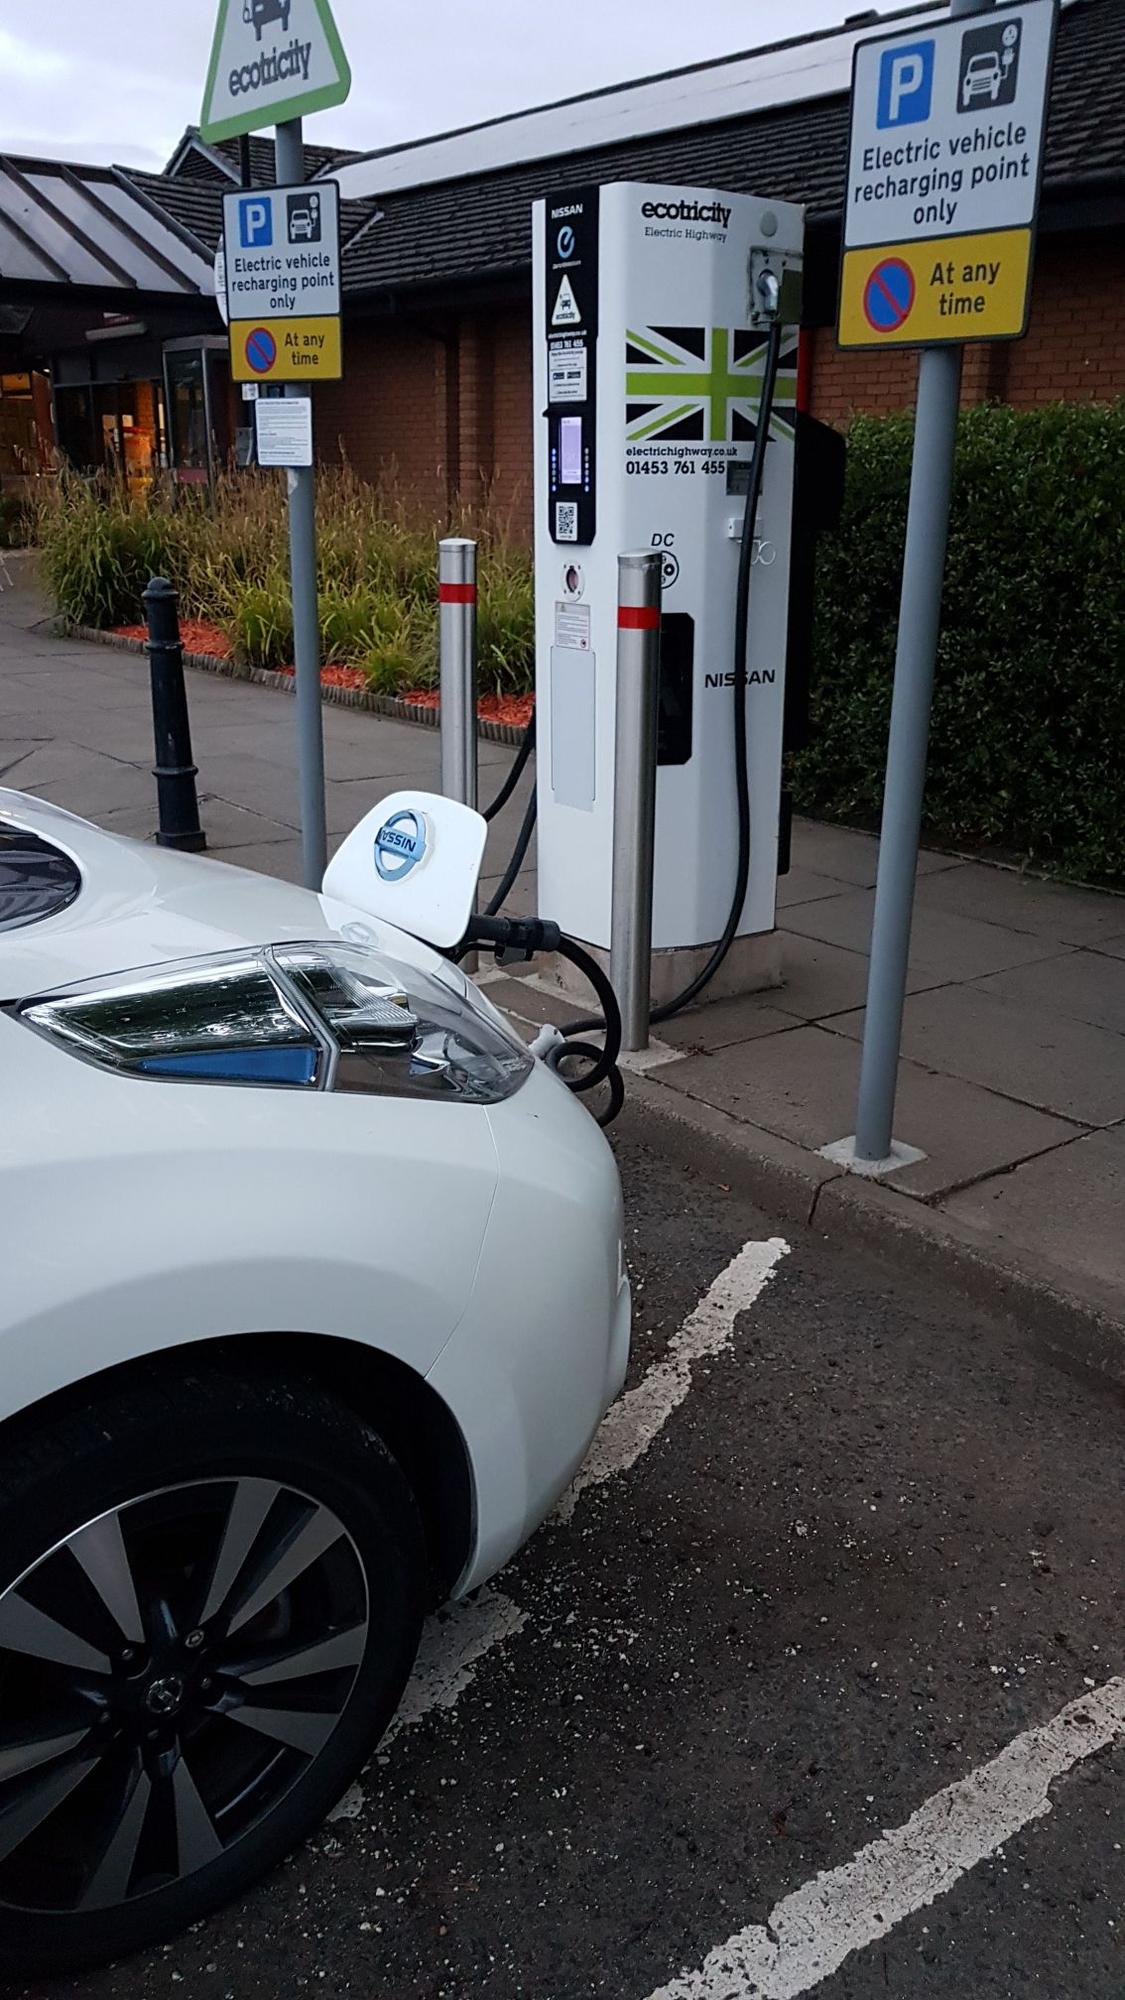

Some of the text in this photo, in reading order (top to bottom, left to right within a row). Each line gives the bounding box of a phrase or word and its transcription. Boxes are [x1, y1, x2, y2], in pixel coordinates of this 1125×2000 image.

[228, 38, 312, 97] ecotricity
[889, 53, 924, 121] P
[862, 121, 1027, 172] Electric vehicle
[854, 152, 1031, 203] recharging point
[551, 203, 584, 219] NISSAN
[641, 199, 732, 229] ecotricity
[912, 197, 958, 225] only
[246, 203, 266, 244] P
[644, 226, 728, 244] Electric Highway
[234, 256, 282, 273] Electric
[285, 252, 331, 269] vehicle
[231, 272, 335, 293] recharging point
[930, 261, 1001, 287] At any
[269, 294, 296, 310] only
[939, 293, 986, 316] time
[284, 332, 326, 350] At any
[291, 350, 319, 366] time
[626, 446, 738, 459] electrichighway.co.uk
[626, 460, 726, 475] 01453 761 455
[650, 533, 676, 547] DC
[381, 828, 417, 853] NISSA
